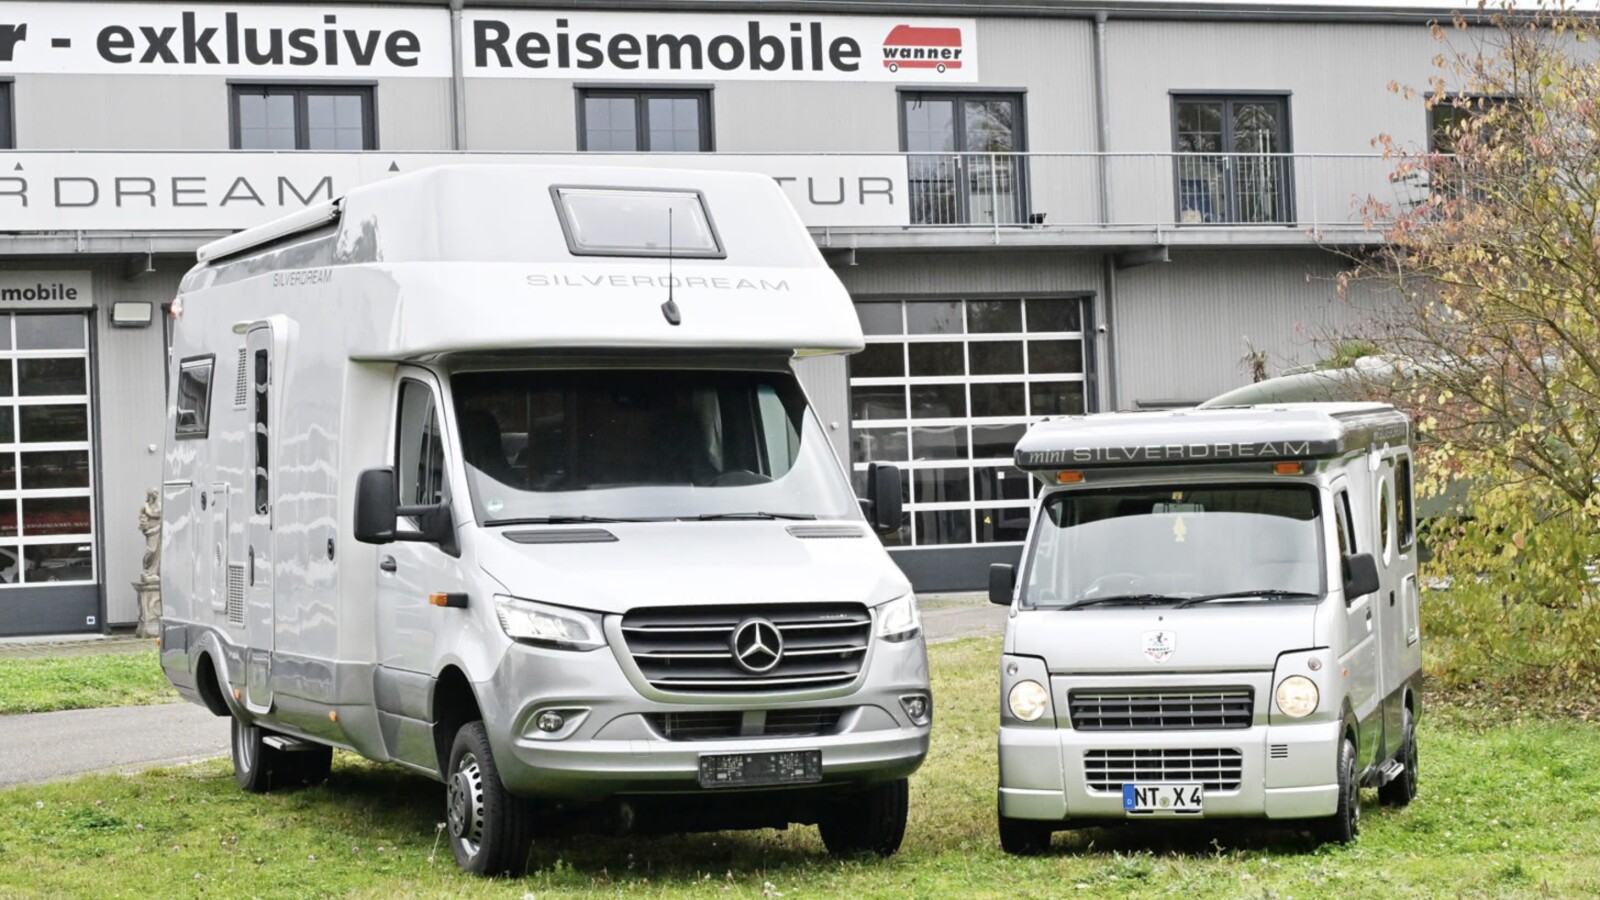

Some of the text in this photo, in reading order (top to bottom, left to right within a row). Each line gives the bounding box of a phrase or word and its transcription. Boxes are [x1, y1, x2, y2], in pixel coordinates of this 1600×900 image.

[96, 12, 421, 66] exklusive
[473, 19, 861, 72] Reisemobile
[883, 47, 962, 59] wanner
[273, 268, 333, 287] SILVERDREAM
[526, 274, 790, 291] SILVERDREAM
[1, 283, 78, 301] mobile
[1029, 441, 1310, 463] mini SILVERDREAM
[1135, 787, 1160, 806] NT
